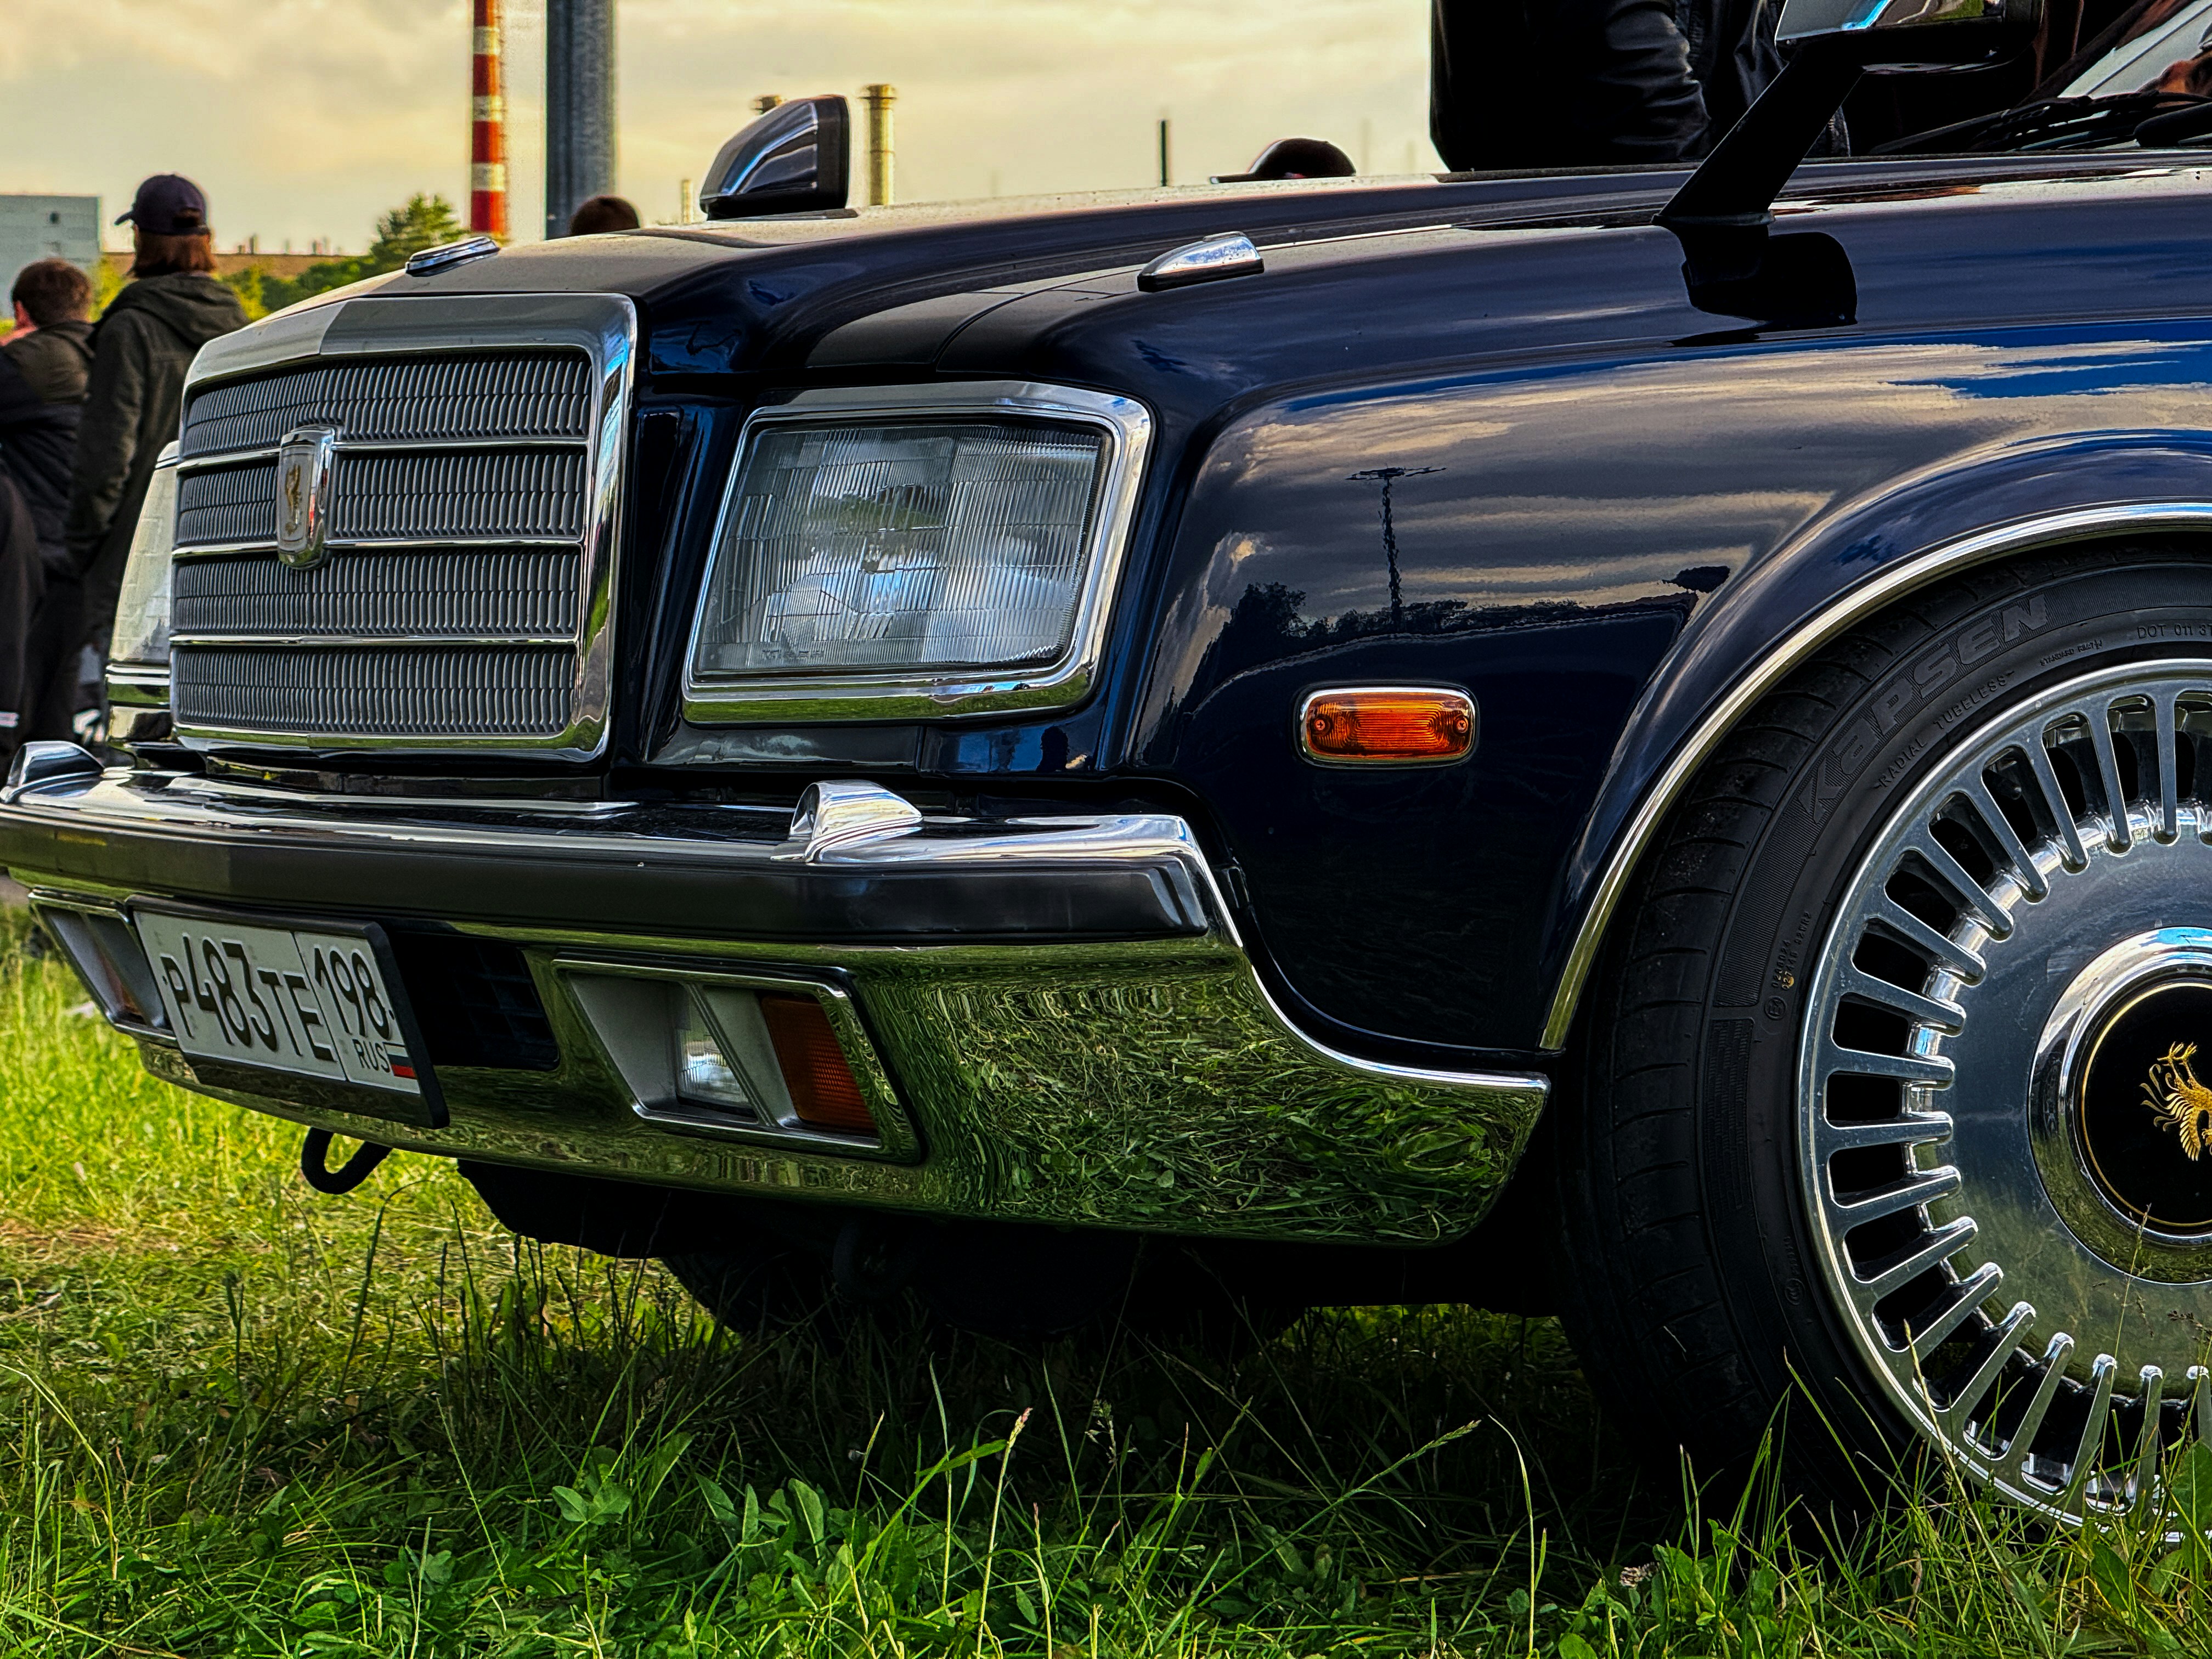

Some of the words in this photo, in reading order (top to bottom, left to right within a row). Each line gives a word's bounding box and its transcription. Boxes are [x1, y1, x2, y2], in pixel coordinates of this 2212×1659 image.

[2137, 624, 2166, 639] DOT
[2039, 647, 2075, 667] STANDARD
[1878, 738, 1928, 789] RADIAL
[1933, 675, 2008, 730] TUBELESS
[161, 935, 338, 1064] P483TE
[314, 946, 390, 1040] 198
[353, 1039, 391, 1073] RUS
